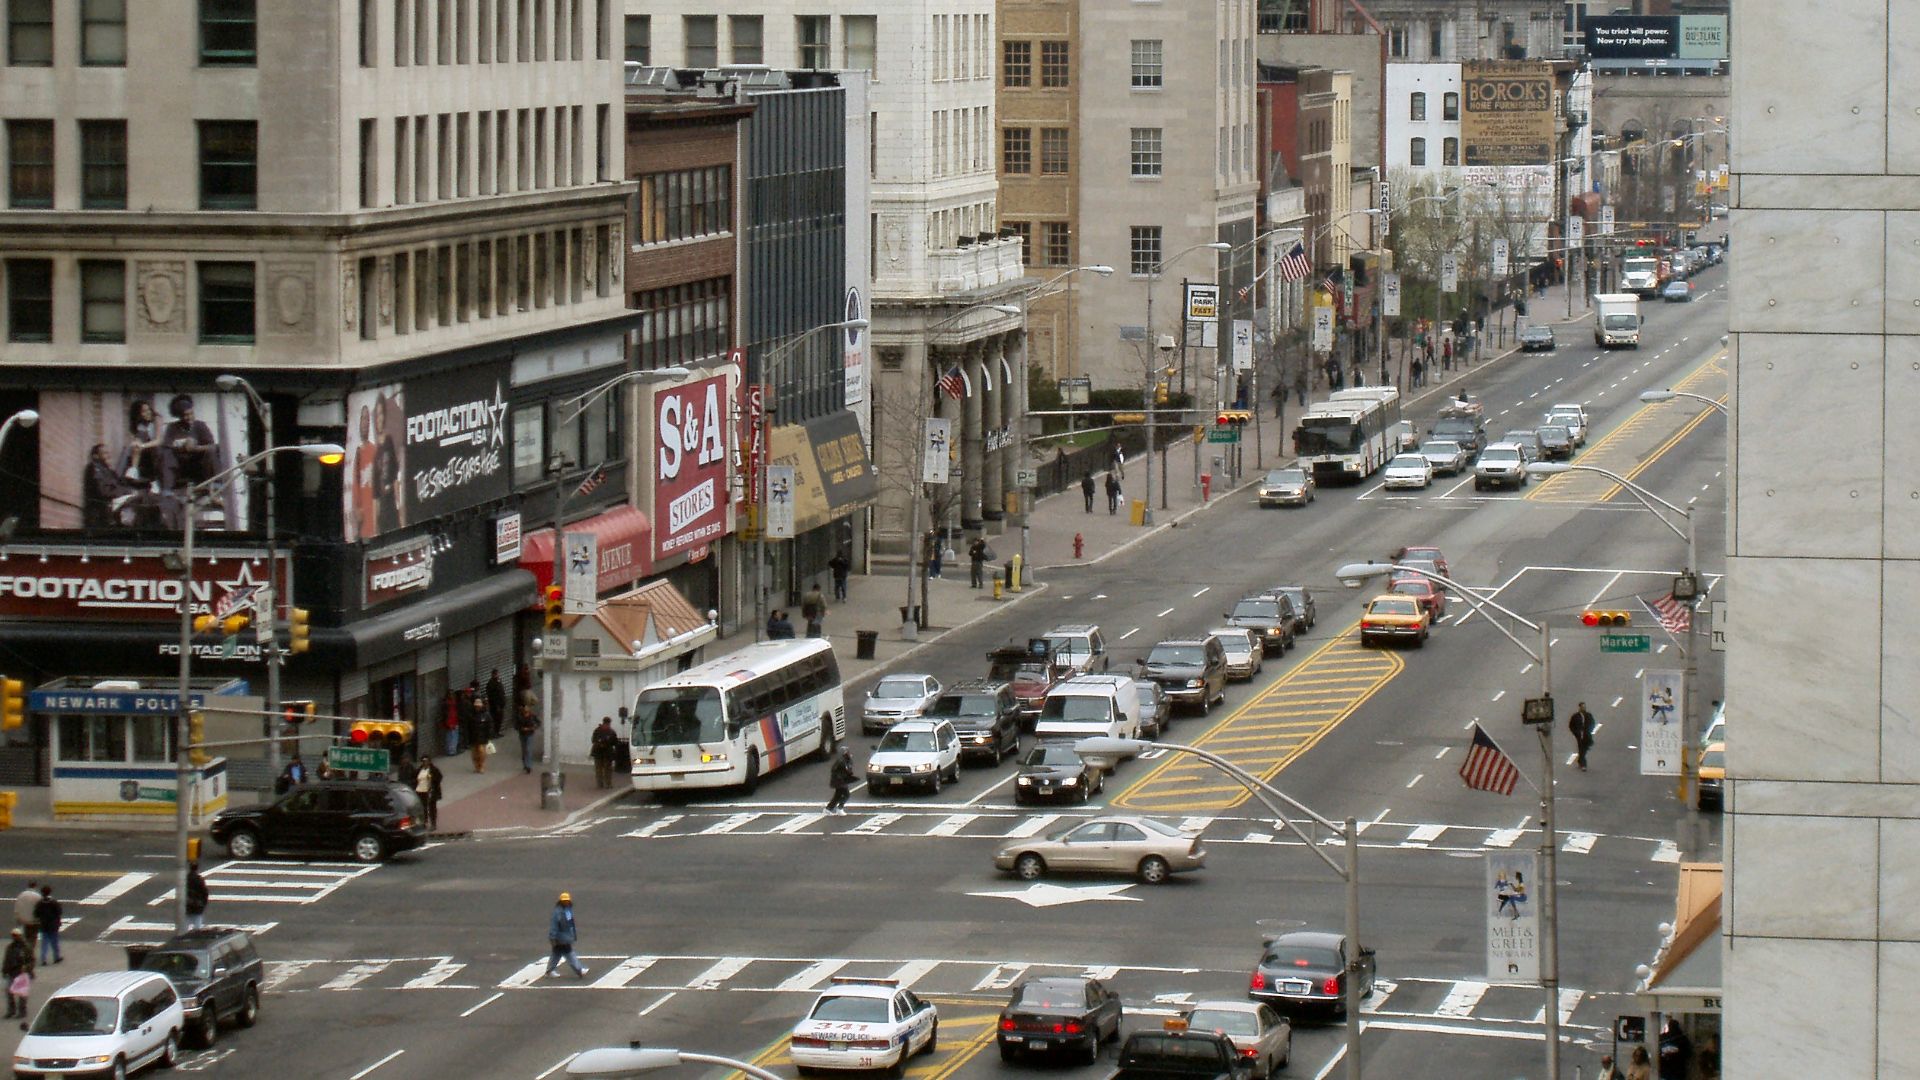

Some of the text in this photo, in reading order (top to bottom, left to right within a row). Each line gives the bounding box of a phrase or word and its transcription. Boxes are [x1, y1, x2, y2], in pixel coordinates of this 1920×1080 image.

[1595, 27, 1670, 37] You tried will power.
[1615, 37, 1627, 46] try
[1642, 37, 1668, 46] phone.
[1470, 82, 1547, 101] BOROK'S
[1471, 101, 1493, 110] HOME
[407, 399, 488, 445] FOOTACTION
[471, 429, 487, 447] USA
[660, 383, 724, 480] S&A
[672, 484, 712, 527] STORES
[600, 542, 632, 574] AVENUE
[0, 575, 212, 602] FOOTACTION
[550, 638, 561, 646] NO
[1601, 636, 1639, 648] Market
[46, 696, 200, 711] NEWARK POLIE
[332, 751, 375, 765] Market
[1491, 938, 1533, 949] GREET
[814, 1021, 869, 1031] 341
[810, 1031, 870, 1041] NEWARK POLICE
